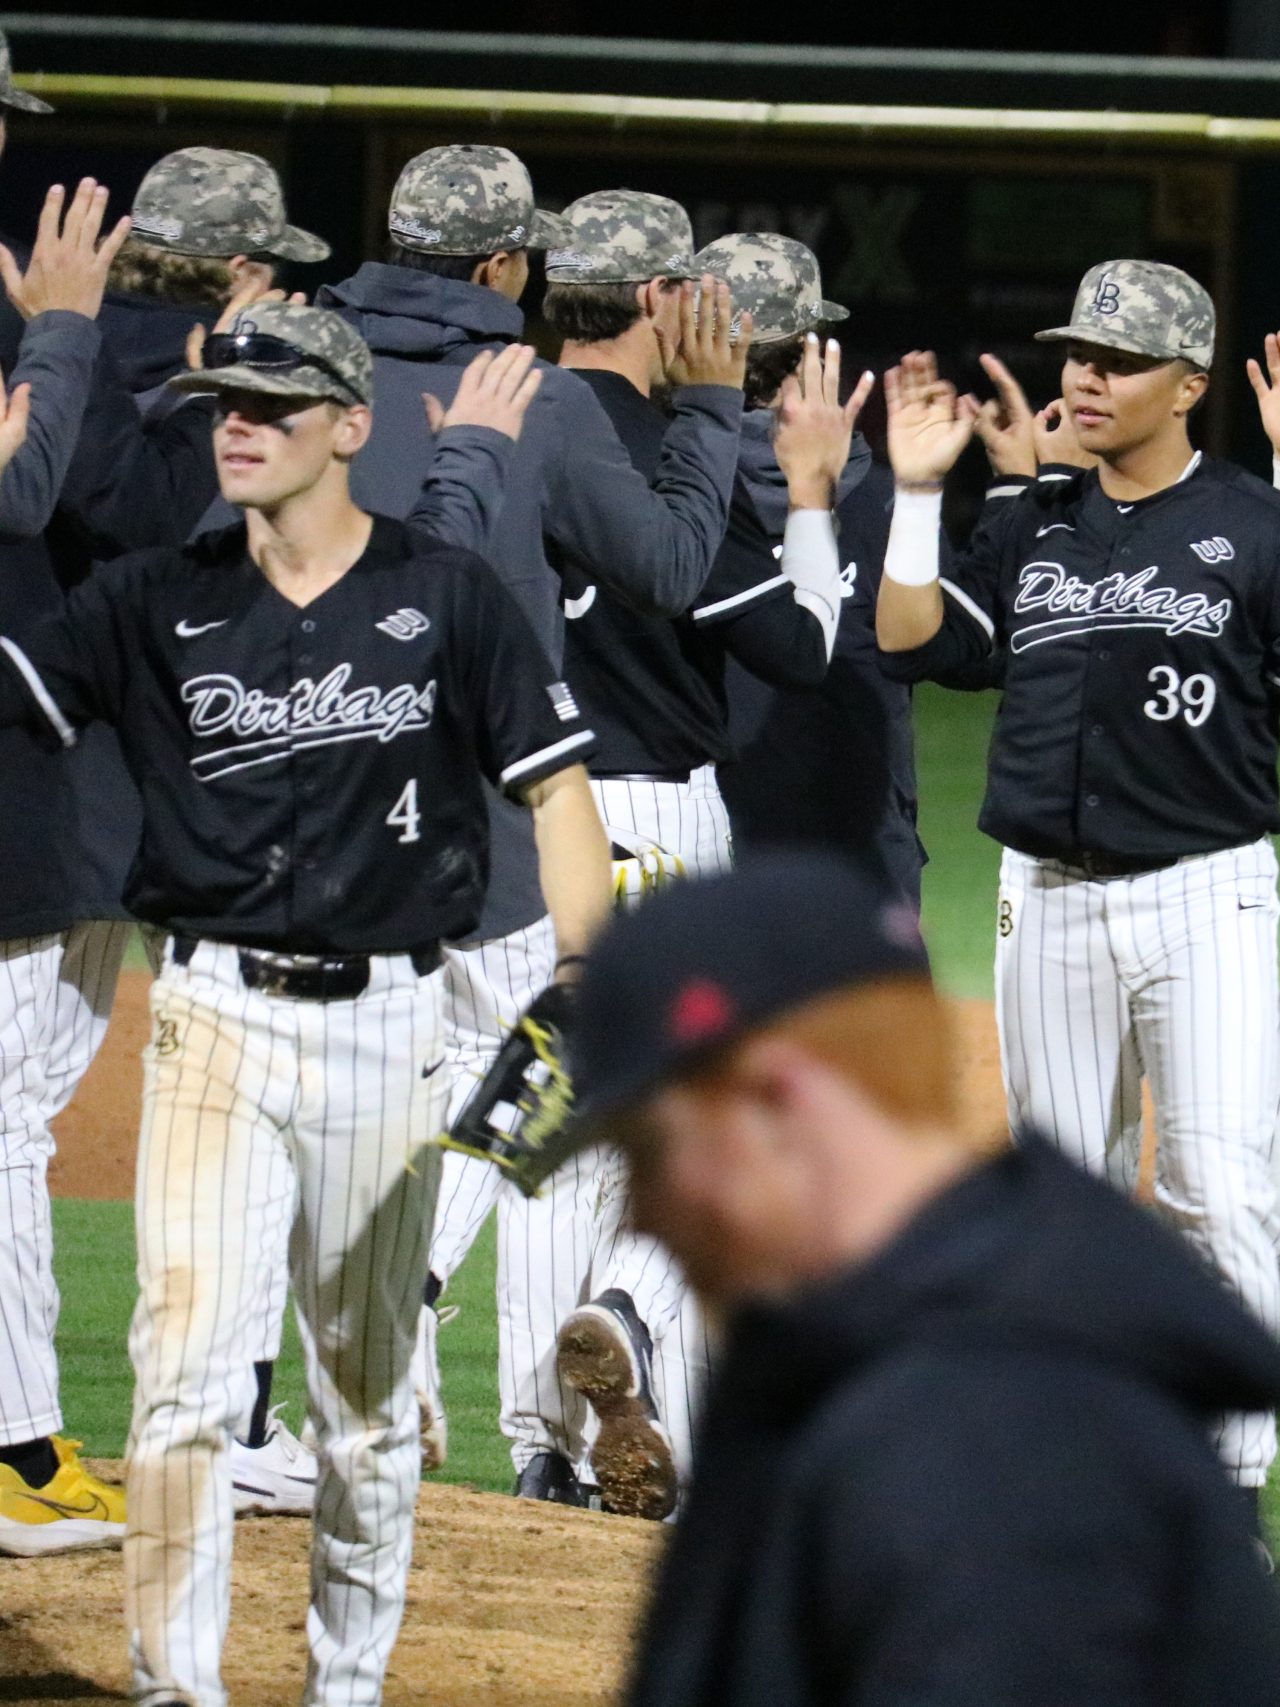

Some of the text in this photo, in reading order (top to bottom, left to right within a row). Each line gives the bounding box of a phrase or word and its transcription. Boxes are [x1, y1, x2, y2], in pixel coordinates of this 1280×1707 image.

[1014, 561, 1232, 637] Dirtbags
[181, 662, 437, 743] Dirtbags
[1143, 664, 1217, 728] 39
[384, 777, 422, 844] 4
